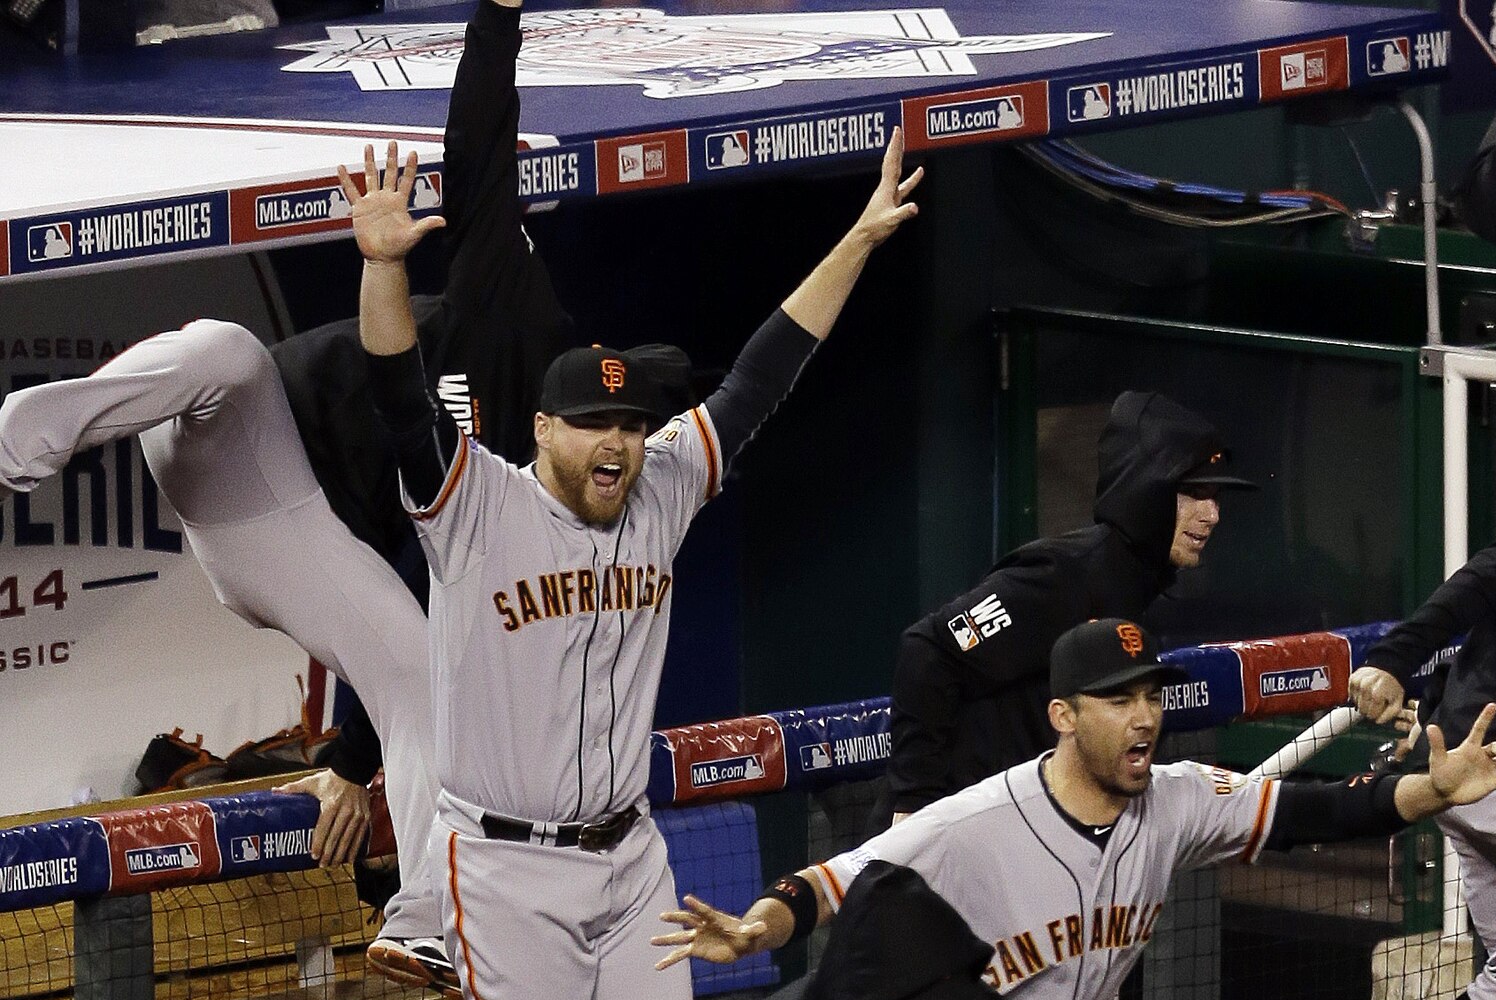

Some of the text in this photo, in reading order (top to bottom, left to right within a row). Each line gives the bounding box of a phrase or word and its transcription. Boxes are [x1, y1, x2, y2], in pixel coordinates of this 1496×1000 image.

[1116, 62, 1245, 117] #WORLDSERIES
[754, 111, 885, 164] #WORLDSERIES
[929, 109, 998, 135] MLB.com
[518, 152, 579, 197] SERIES
[78, 201, 212, 255] #WORLDSERIES
[258, 198, 328, 225] MLB.com
[492, 573, 562, 633] SAN
[969, 593, 1013, 639] WS
[1263, 676, 1310, 693] MLB.com
[693, 764, 744, 785] MLB.com
[129, 853, 181, 871] MLB.com
